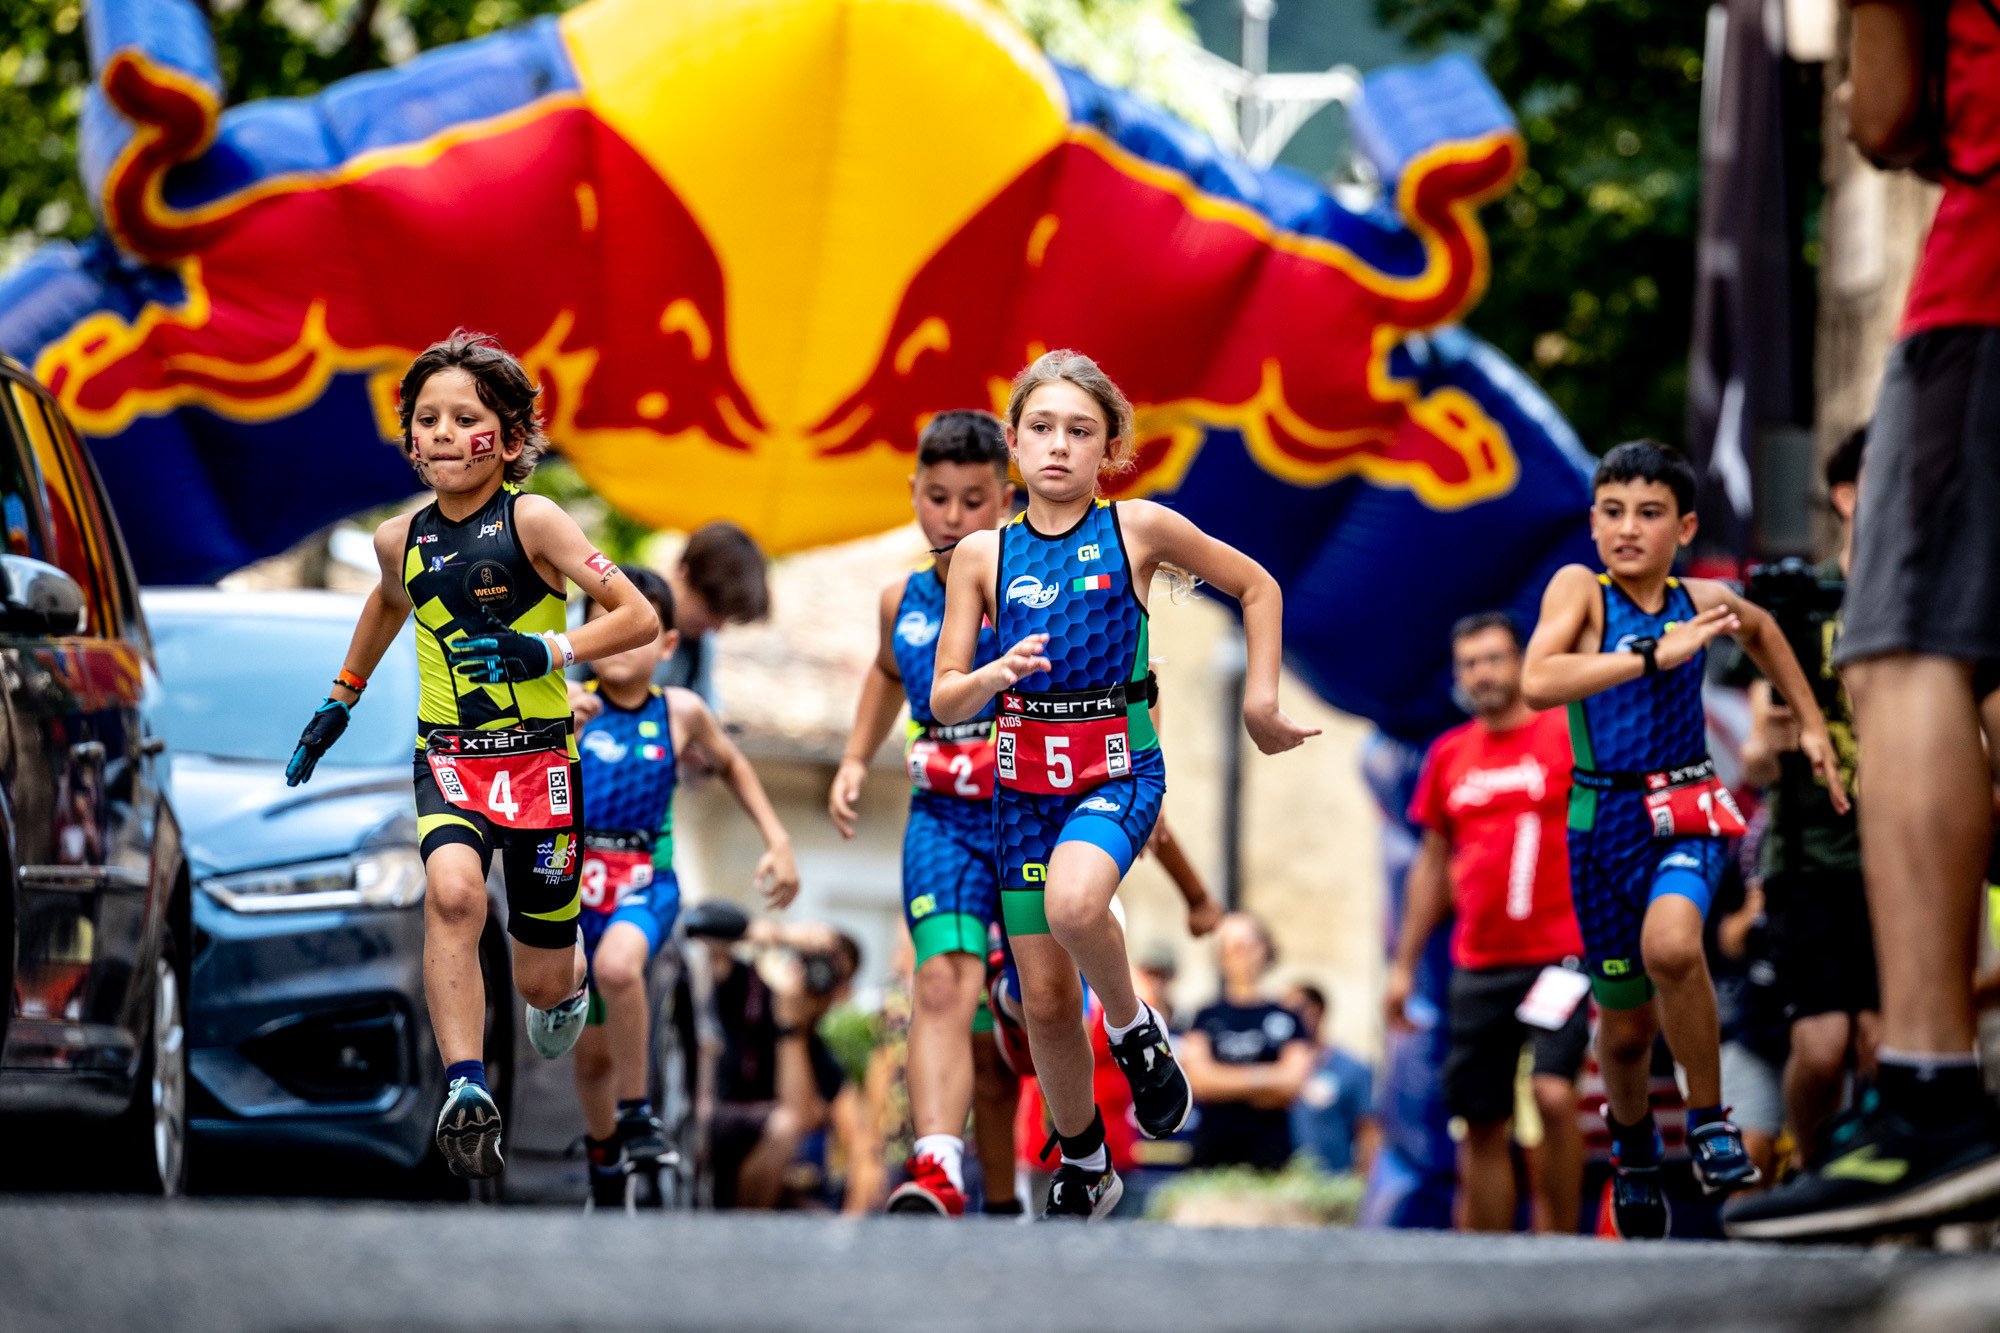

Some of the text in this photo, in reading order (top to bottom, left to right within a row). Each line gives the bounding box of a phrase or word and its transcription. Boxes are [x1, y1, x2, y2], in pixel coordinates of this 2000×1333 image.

[474, 586, 508, 597] WELEDA
[999, 716, 1022, 728] KIDS
[948, 754, 979, 795] 2
[1044, 735, 1074, 788] 5
[488, 770, 519, 821] 4
[544, 875, 560, 885] TRI
[580, 859, 608, 907] 3
